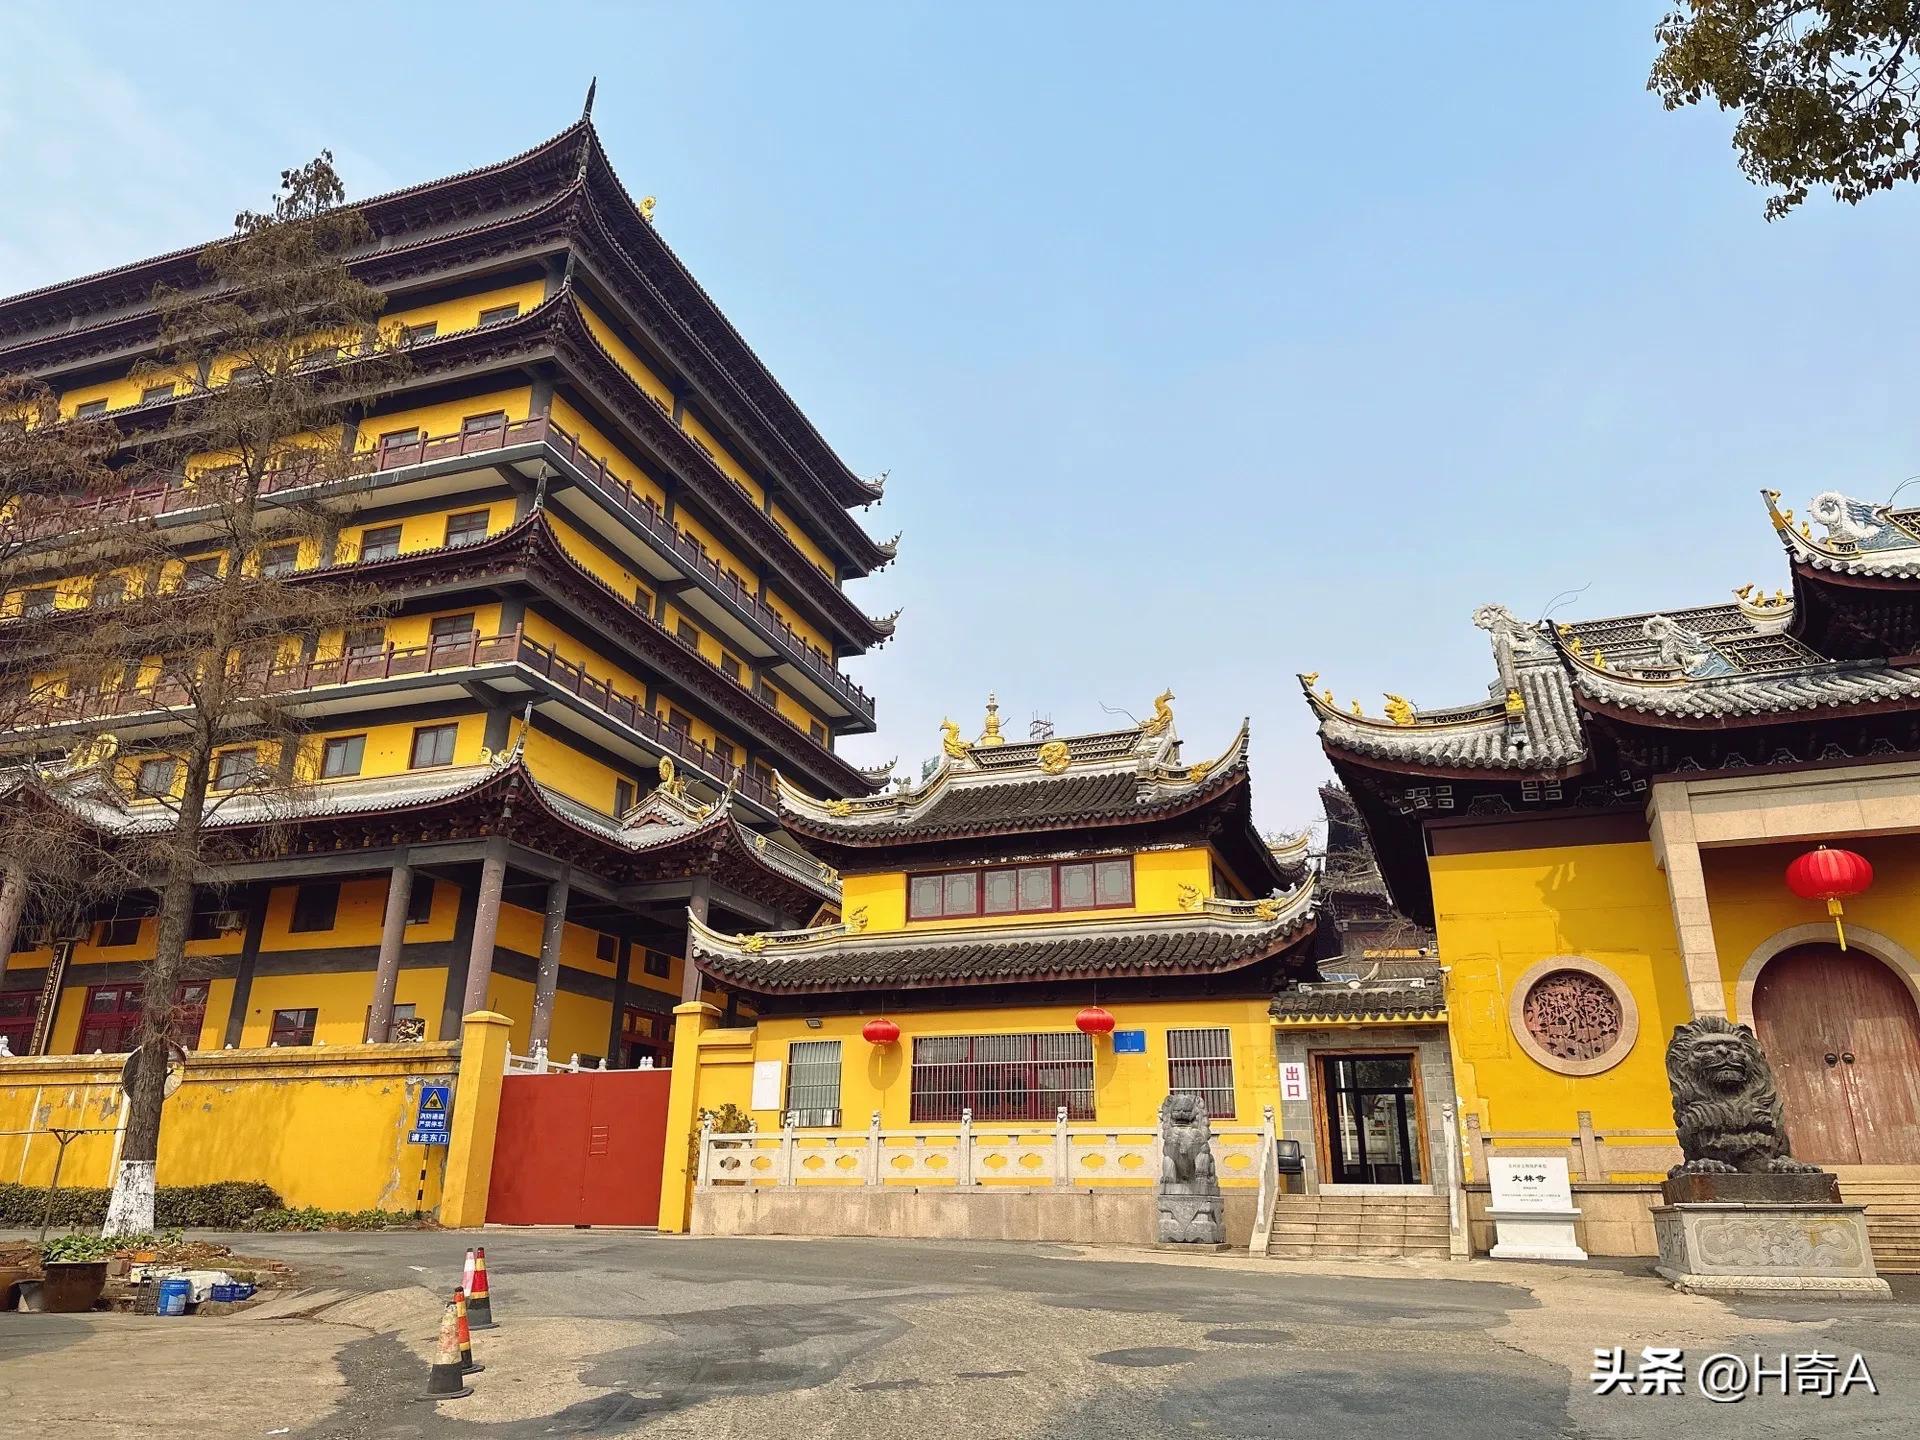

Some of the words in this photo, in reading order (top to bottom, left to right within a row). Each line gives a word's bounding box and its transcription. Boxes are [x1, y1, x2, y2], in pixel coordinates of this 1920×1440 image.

[1286, 1066, 1300, 1097] 出口
[411, 1133, 447, 1142] 请走东门
[1512, 1174, 1547, 1183] 大林寺
